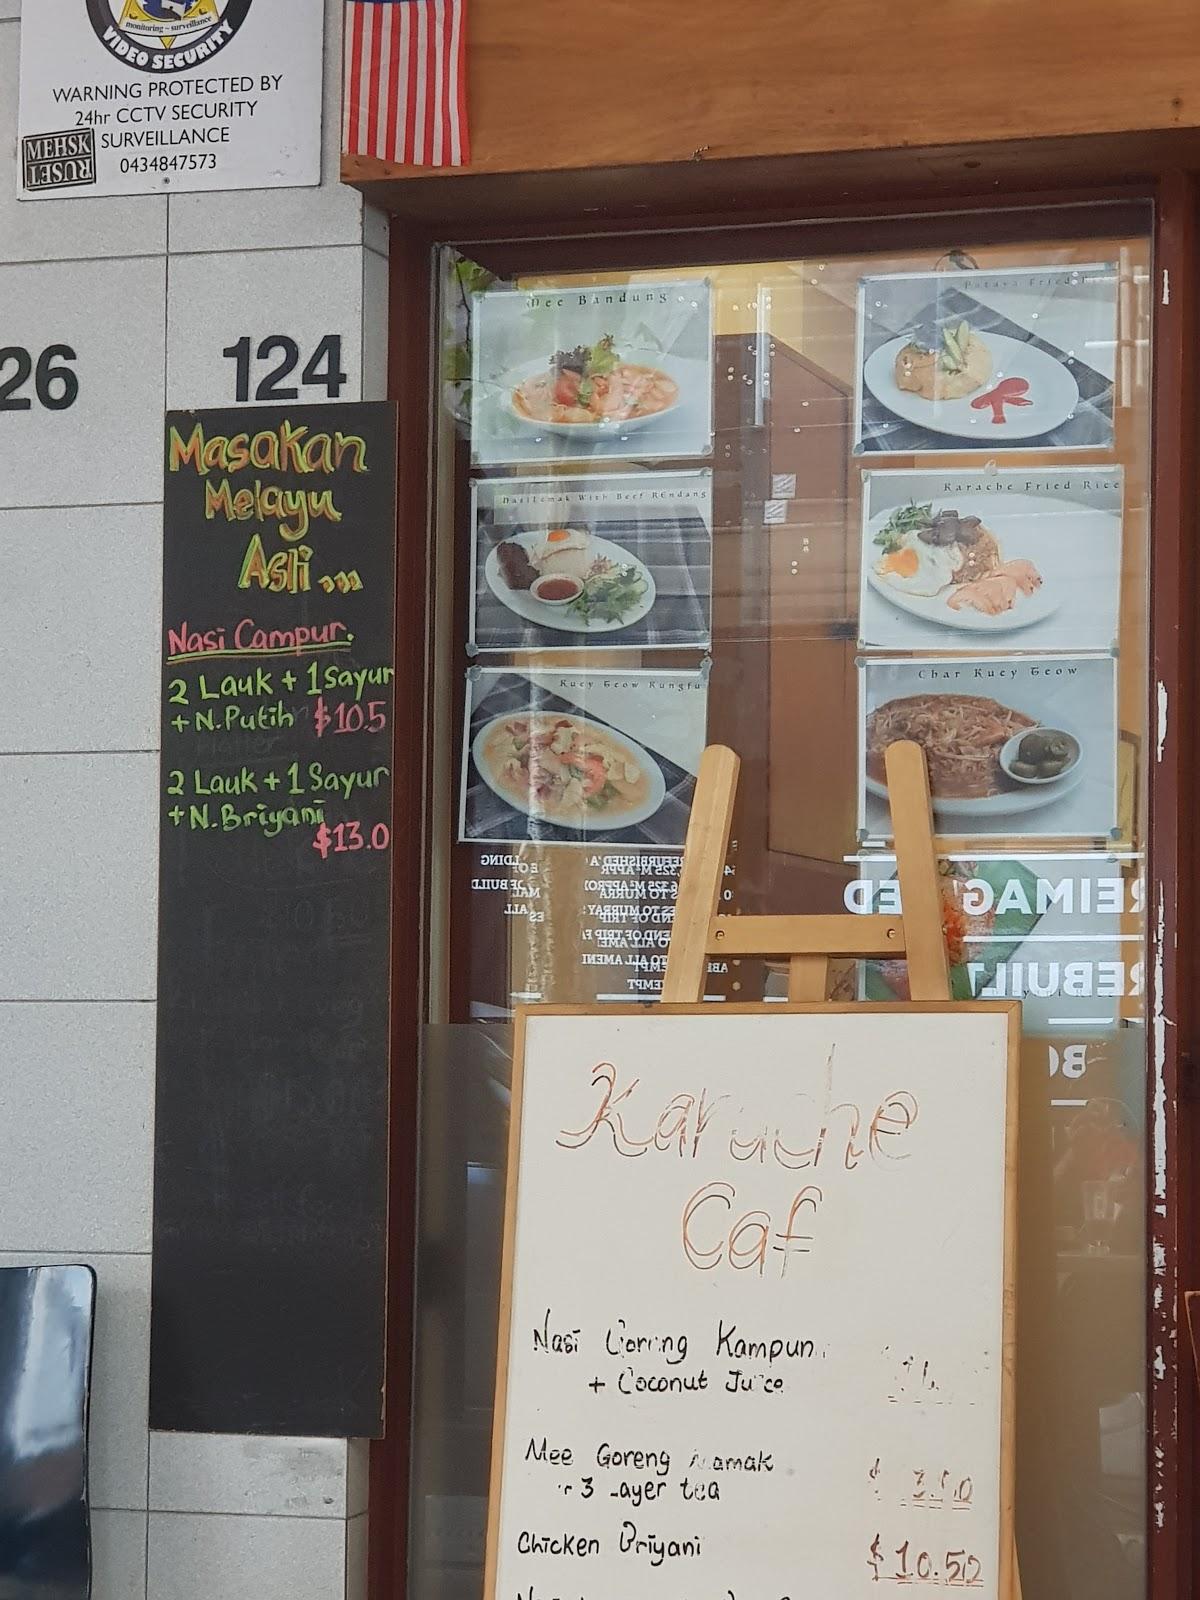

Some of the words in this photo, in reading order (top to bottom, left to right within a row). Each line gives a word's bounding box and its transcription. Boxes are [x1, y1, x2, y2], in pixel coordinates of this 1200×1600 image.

[126, 20, 164, 33] monitoring
[171, 16, 212, 32] surveillance
[103, 25, 149, 66] VIDEO
[152, 19, 233, 69] SECURITY
[53, 83, 142, 102] WARNING
[149, 76, 254, 98] PROTECTED
[260, 74, 283, 91] BY
[75, 109, 110, 126] 24hr
[116, 105, 166, 124] CCTV
[172, 100, 258, 120] SECURITY
[26, 132, 91, 161] MEHSK
[101, 127, 230, 149] SURVEILLANCE
[120, 153, 217, 173] 0434847573
[579, 292, 668, 306] Bandung
[223, 334, 347, 402] 124
[169, 419, 370, 476] Masakan
[1024, 481, 1071, 491] Fried
[1083, 480, 1120, 490] Rice
[204, 478, 343, 542] Melayu
[237, 534, 314, 594] Asli
[167, 621, 226, 655] Nasi
[168, 679, 189, 704] 2
[199, 667, 273, 700] Lauk
[281, 670, 297, 691] +
[918, 669, 961, 679] Char
[974, 668, 1018, 680] Kuey
[167, 770, 185, 796] 2
[194, 766, 259, 795] Lauk
[264, 771, 280, 791] +
[287, 762, 305, 795] 1
[308, 761, 390, 800] Sayur
[312, 820, 390, 859] $13.0
[532, 1307, 581, 1354] Nasi
[589, 1376, 606, 1394] +
[618, 1367, 708, 1394] Coconut
[525, 1437, 574, 1466] Mee
[597, 1443, 670, 1476] Goreng
[581, 1476, 594, 1498] 3
[517, 1531, 600, 1557] Chicken
